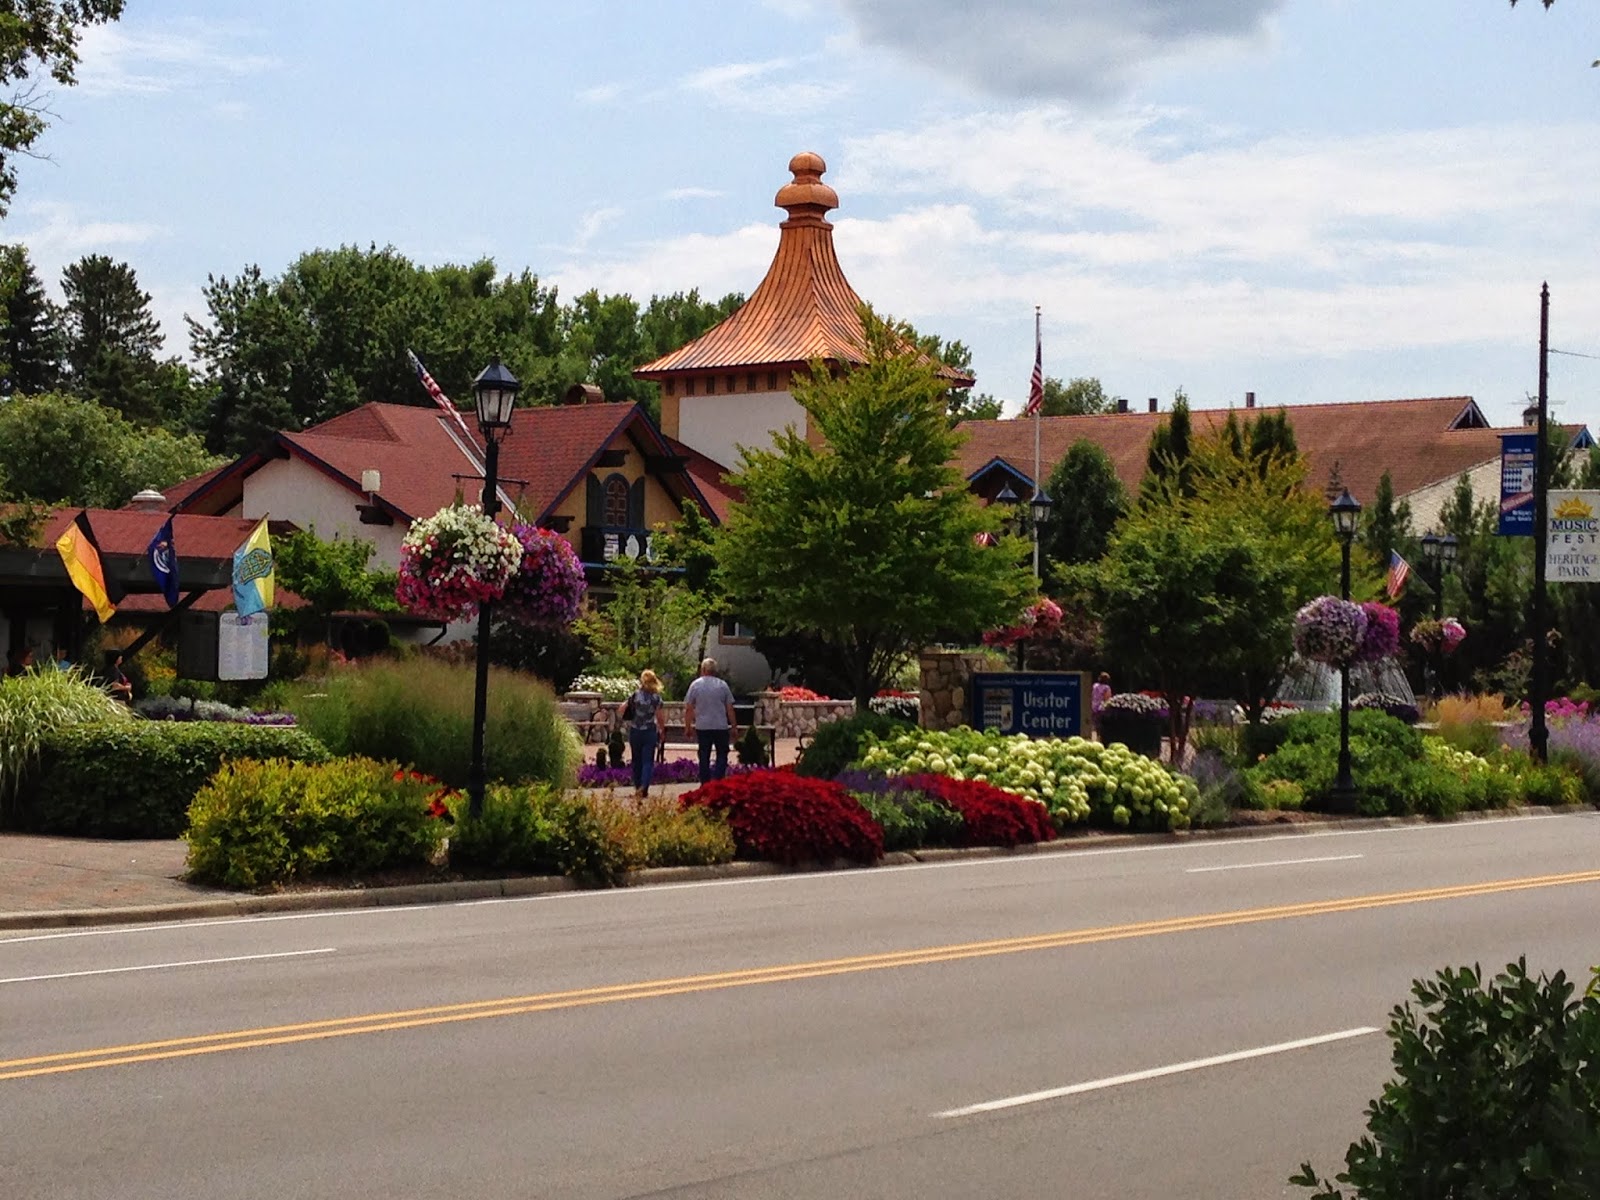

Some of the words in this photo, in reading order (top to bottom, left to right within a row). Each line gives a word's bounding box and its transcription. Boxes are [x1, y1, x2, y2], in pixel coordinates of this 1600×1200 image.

[1552, 520, 1597, 530] MUSIC
[1552, 534, 1597, 544] FEST
[1548, 554, 1599, 564] HERITAGE
[1558, 566, 1590, 576] PARK
[1023, 691, 1071, 709] Visitor
[1022, 711, 1072, 729] Center
